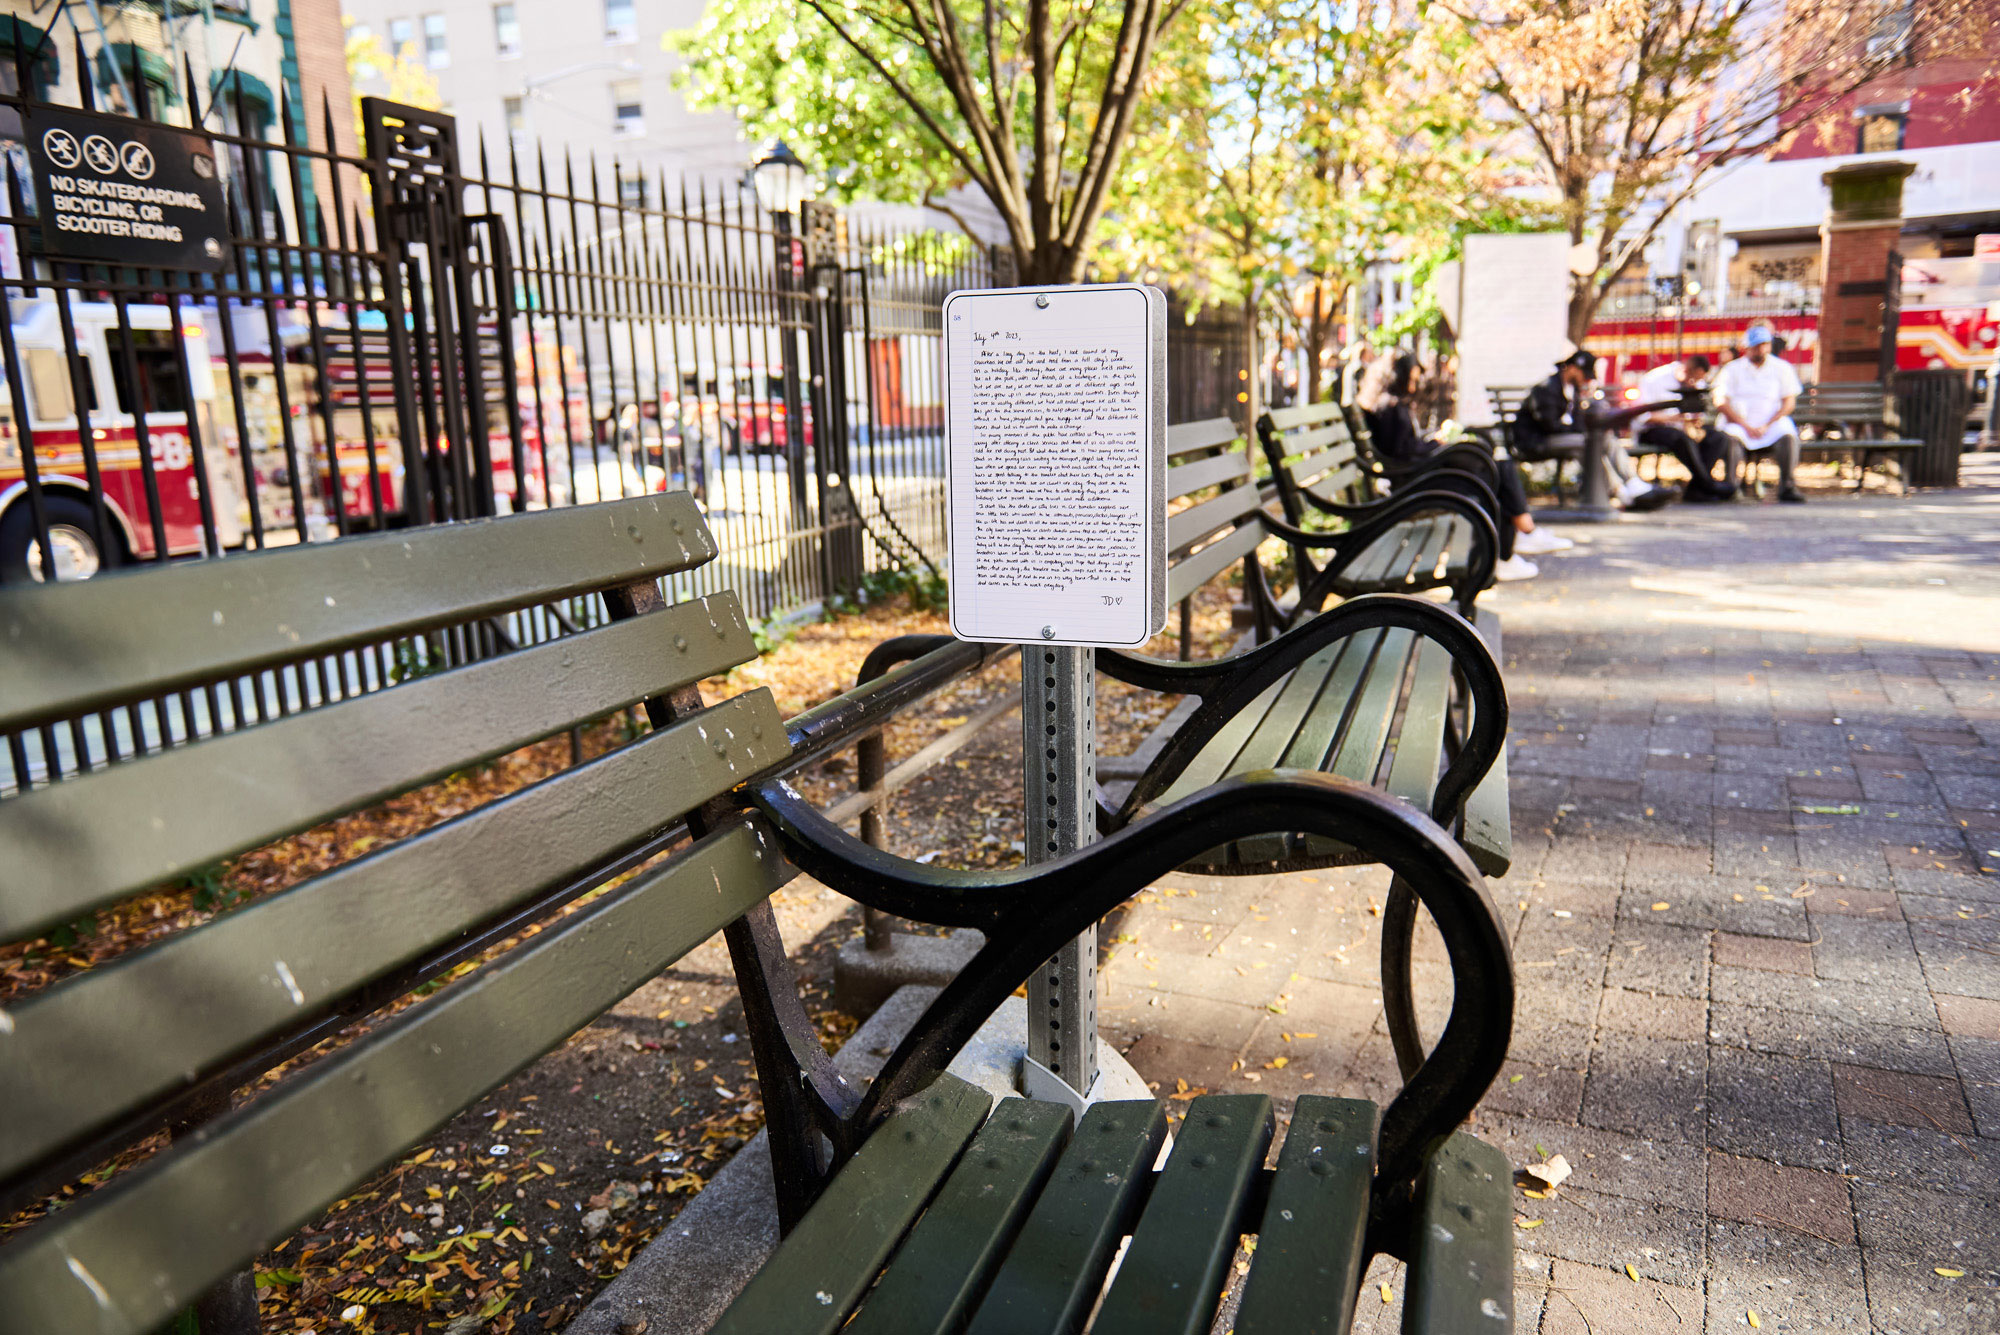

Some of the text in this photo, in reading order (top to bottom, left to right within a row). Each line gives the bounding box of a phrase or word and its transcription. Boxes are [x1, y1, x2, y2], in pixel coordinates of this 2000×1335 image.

[49, 174, 206, 211] NO SKATEBOARDING,
[52, 194, 163, 222] BICYCLING, OR
[56, 215, 183, 242] SCOOTER RIDING
[973, 331, 986, 346] July
[1102, 595, 1113, 605] JD
